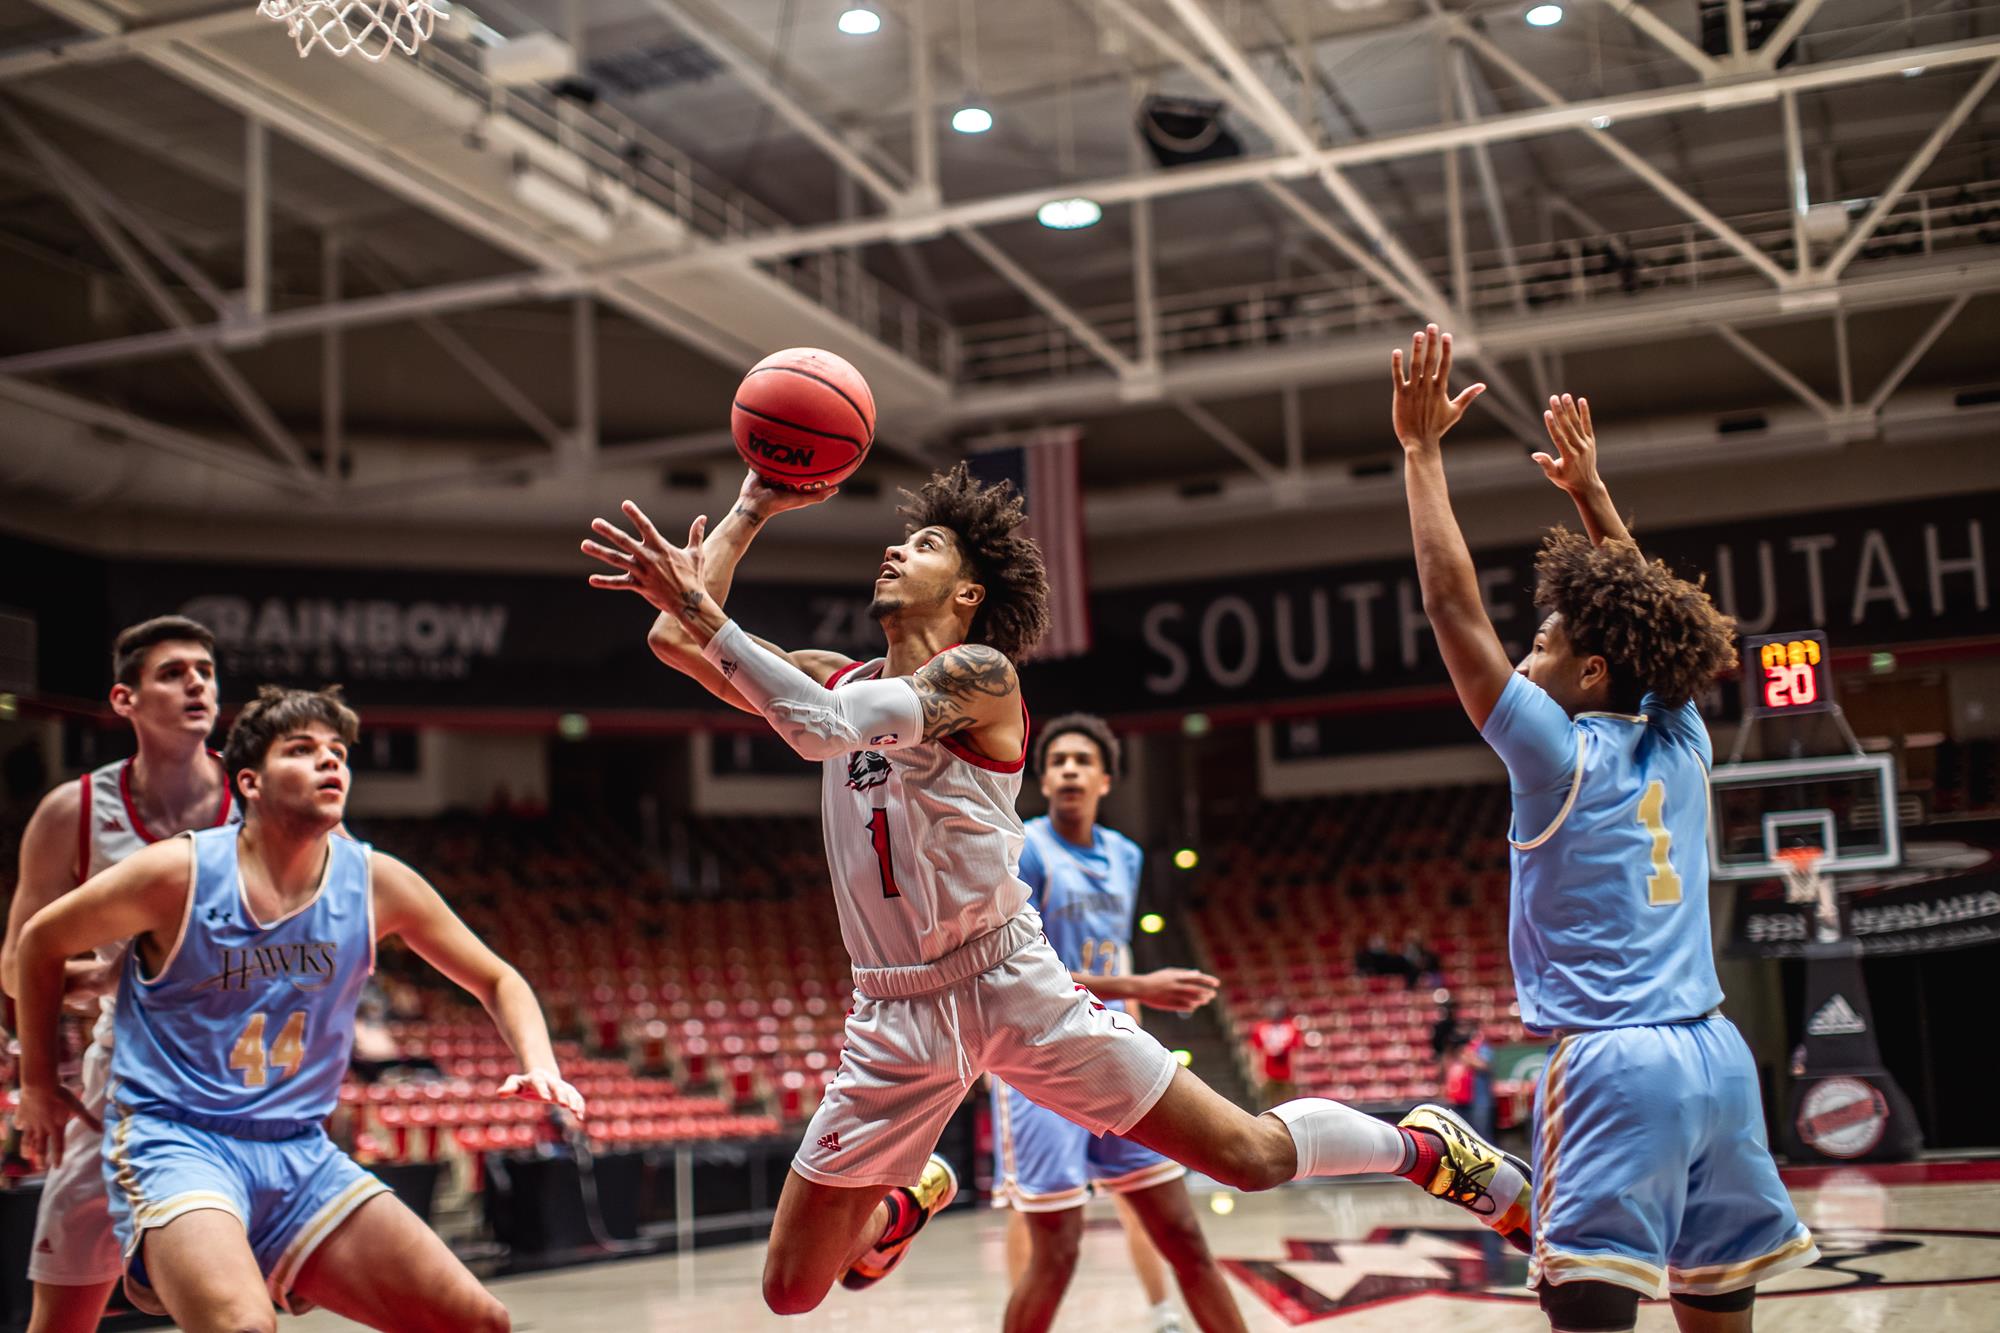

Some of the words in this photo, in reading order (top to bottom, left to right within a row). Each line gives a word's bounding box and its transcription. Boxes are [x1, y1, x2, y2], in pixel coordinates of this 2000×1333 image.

[749, 432, 815, 467] NCAA
[1716, 518, 1988, 633] UTAH
[186, 597, 510, 657] RAINBOW
[1765, 664, 1817, 708] 20
[865, 807, 901, 898] 1
[1636, 779, 1683, 907] 1
[216, 942, 337, 991] HAWKS
[229, 1011, 306, 1088] 44
